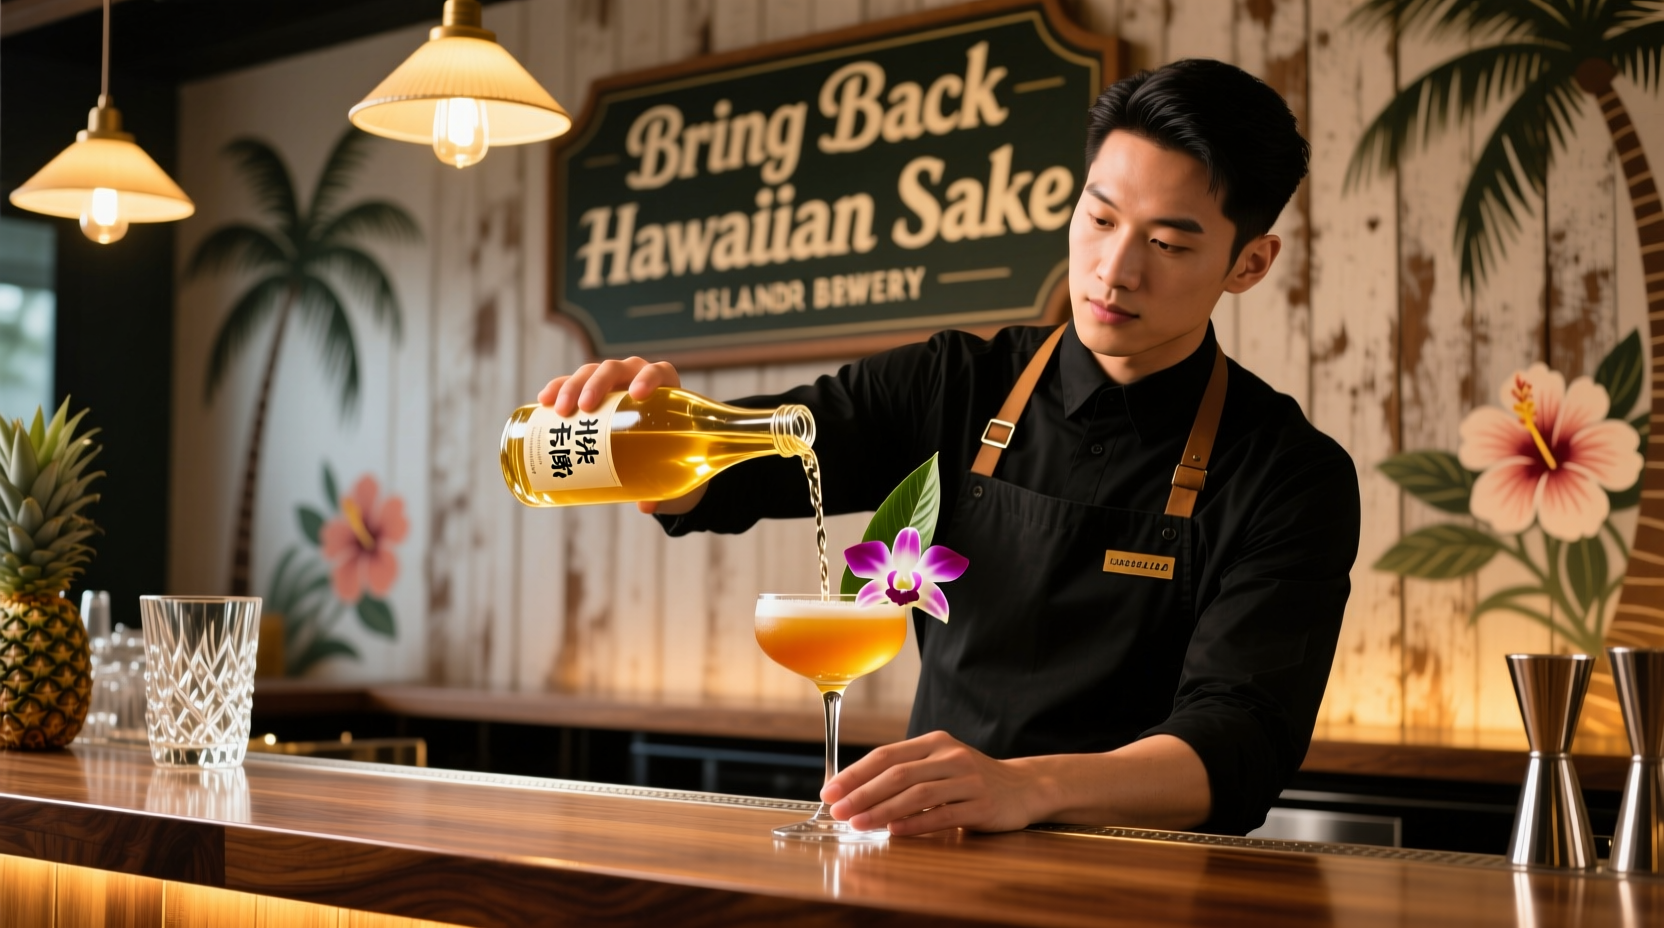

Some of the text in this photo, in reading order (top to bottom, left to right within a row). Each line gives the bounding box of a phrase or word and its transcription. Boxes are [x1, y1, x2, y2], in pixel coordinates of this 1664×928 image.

[626, 41, 1010, 190] Bring Back
[577, 144, 1075, 289] Hawaiian Sake
